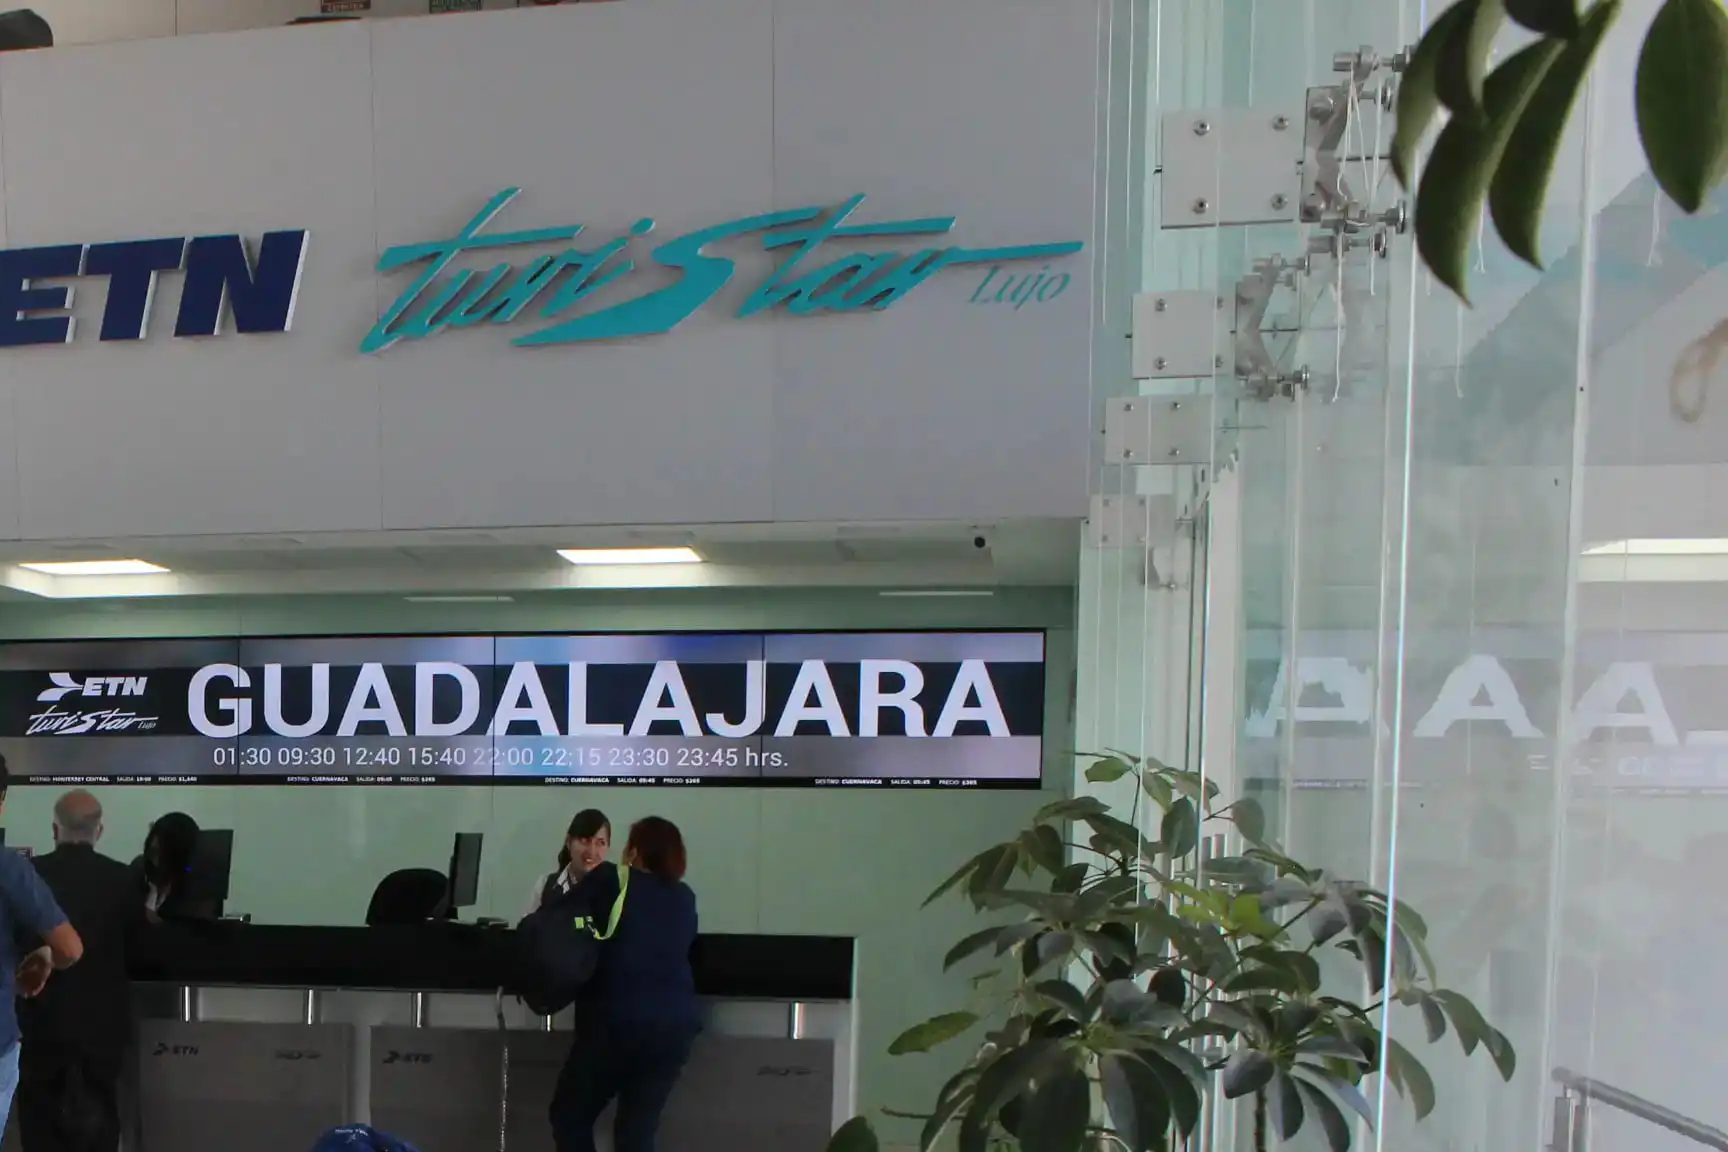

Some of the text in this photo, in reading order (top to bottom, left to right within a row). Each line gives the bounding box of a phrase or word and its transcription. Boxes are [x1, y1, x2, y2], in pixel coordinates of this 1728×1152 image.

[969, 264, 1070, 311] Lujo
[82, 677, 148, 696] ETN
[187, 660, 1012, 740] GUADALAJARA
[214, 747, 789, 766] 01:30 09:30 12:40 15:40 22:00 22:15 23:30 23:45 hrs.
